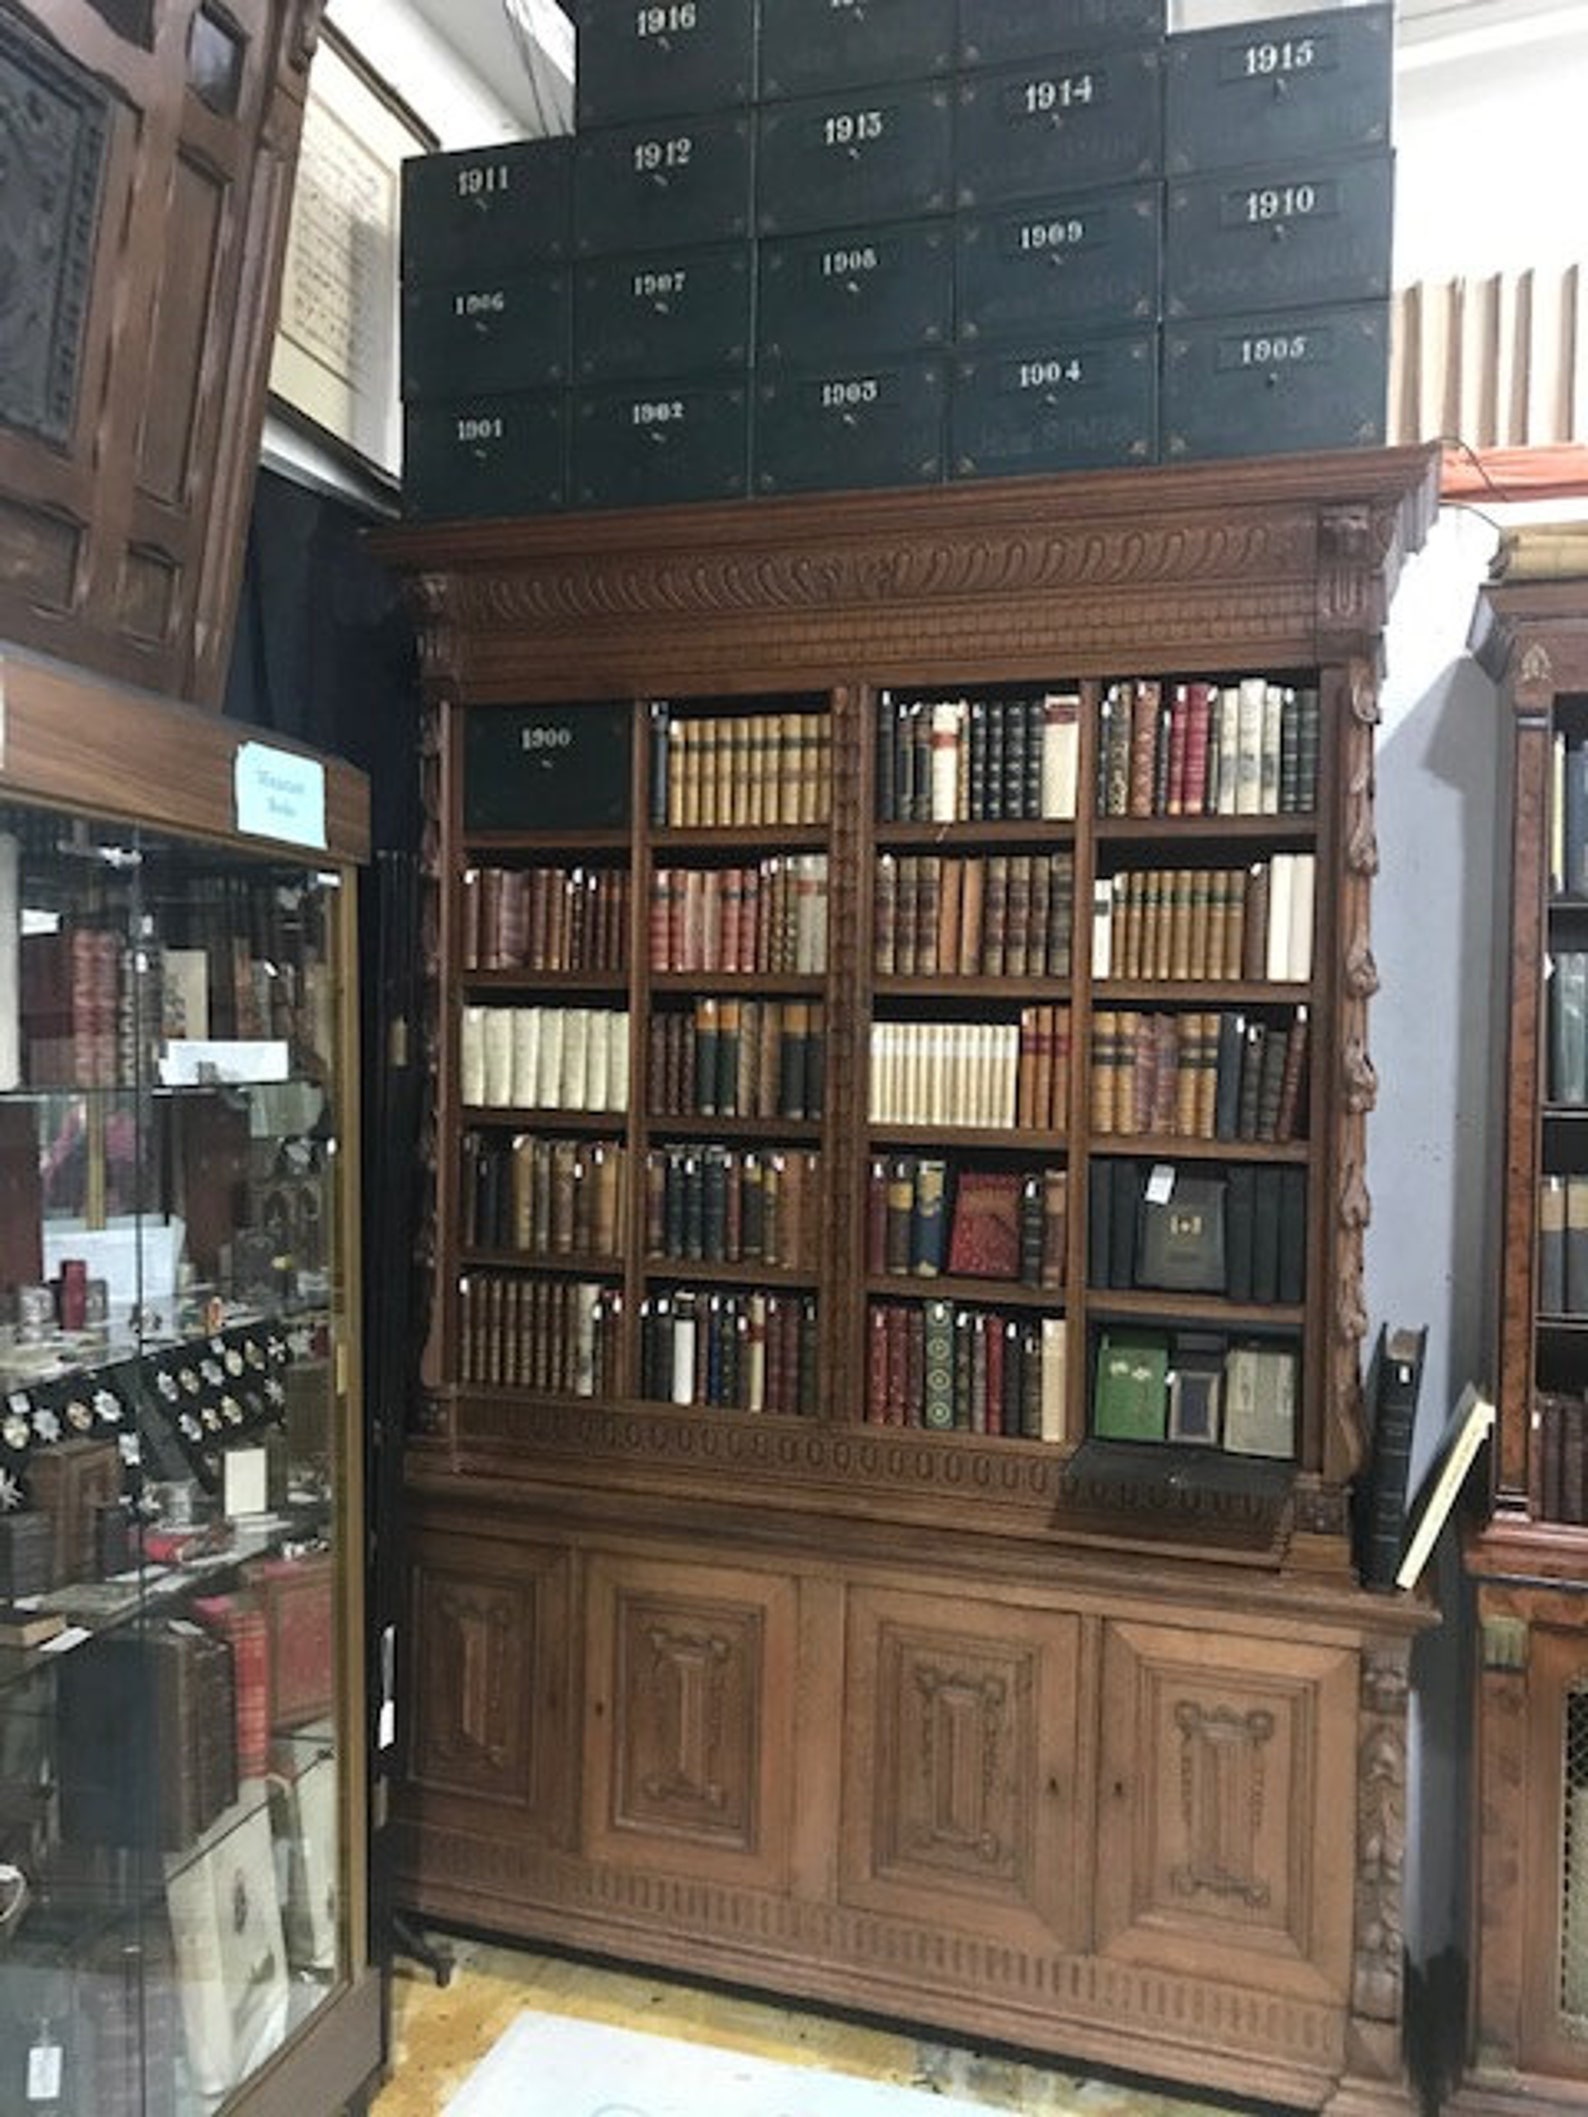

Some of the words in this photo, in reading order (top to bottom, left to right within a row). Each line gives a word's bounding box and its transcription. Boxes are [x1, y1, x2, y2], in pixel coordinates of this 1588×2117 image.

[637, 3, 696, 36] 1916
[1025, 75, 1093, 113] 1914
[634, 137, 692, 171] 1912
[458, 165, 508, 196] 1911
[1247, 186, 1315, 221] 1910
[1021, 220, 1083, 249] 1909
[634, 271, 686, 296] 1907
[1020, 360, 1081, 388] 1904
[633, 401, 683, 424] 1902
[458, 418, 502, 441] 1901
[522, 727, 572, 750] 1900
